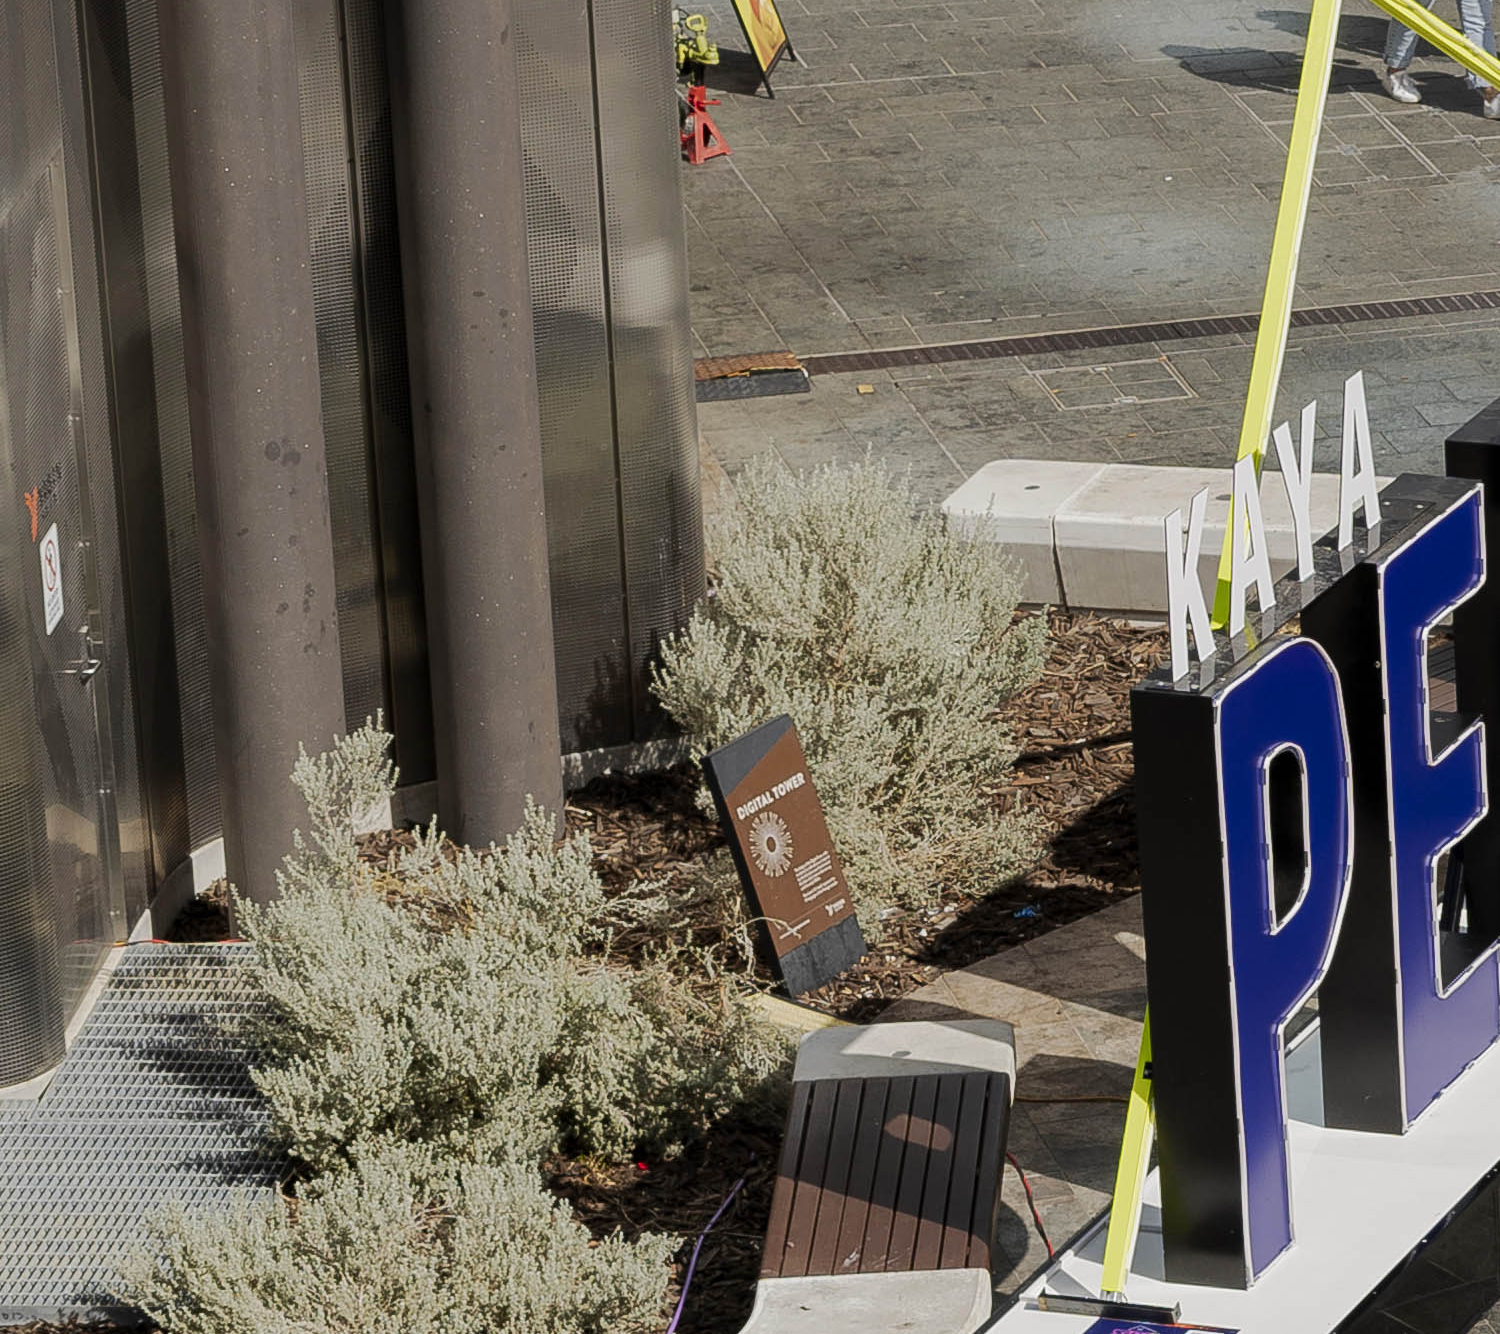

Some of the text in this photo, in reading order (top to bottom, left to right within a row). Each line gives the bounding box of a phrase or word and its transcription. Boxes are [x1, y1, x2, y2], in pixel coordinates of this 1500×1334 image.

[1163, 370, 1381, 680] KAYA
[736, 771, 806, 821] DIGITAL TOWER
